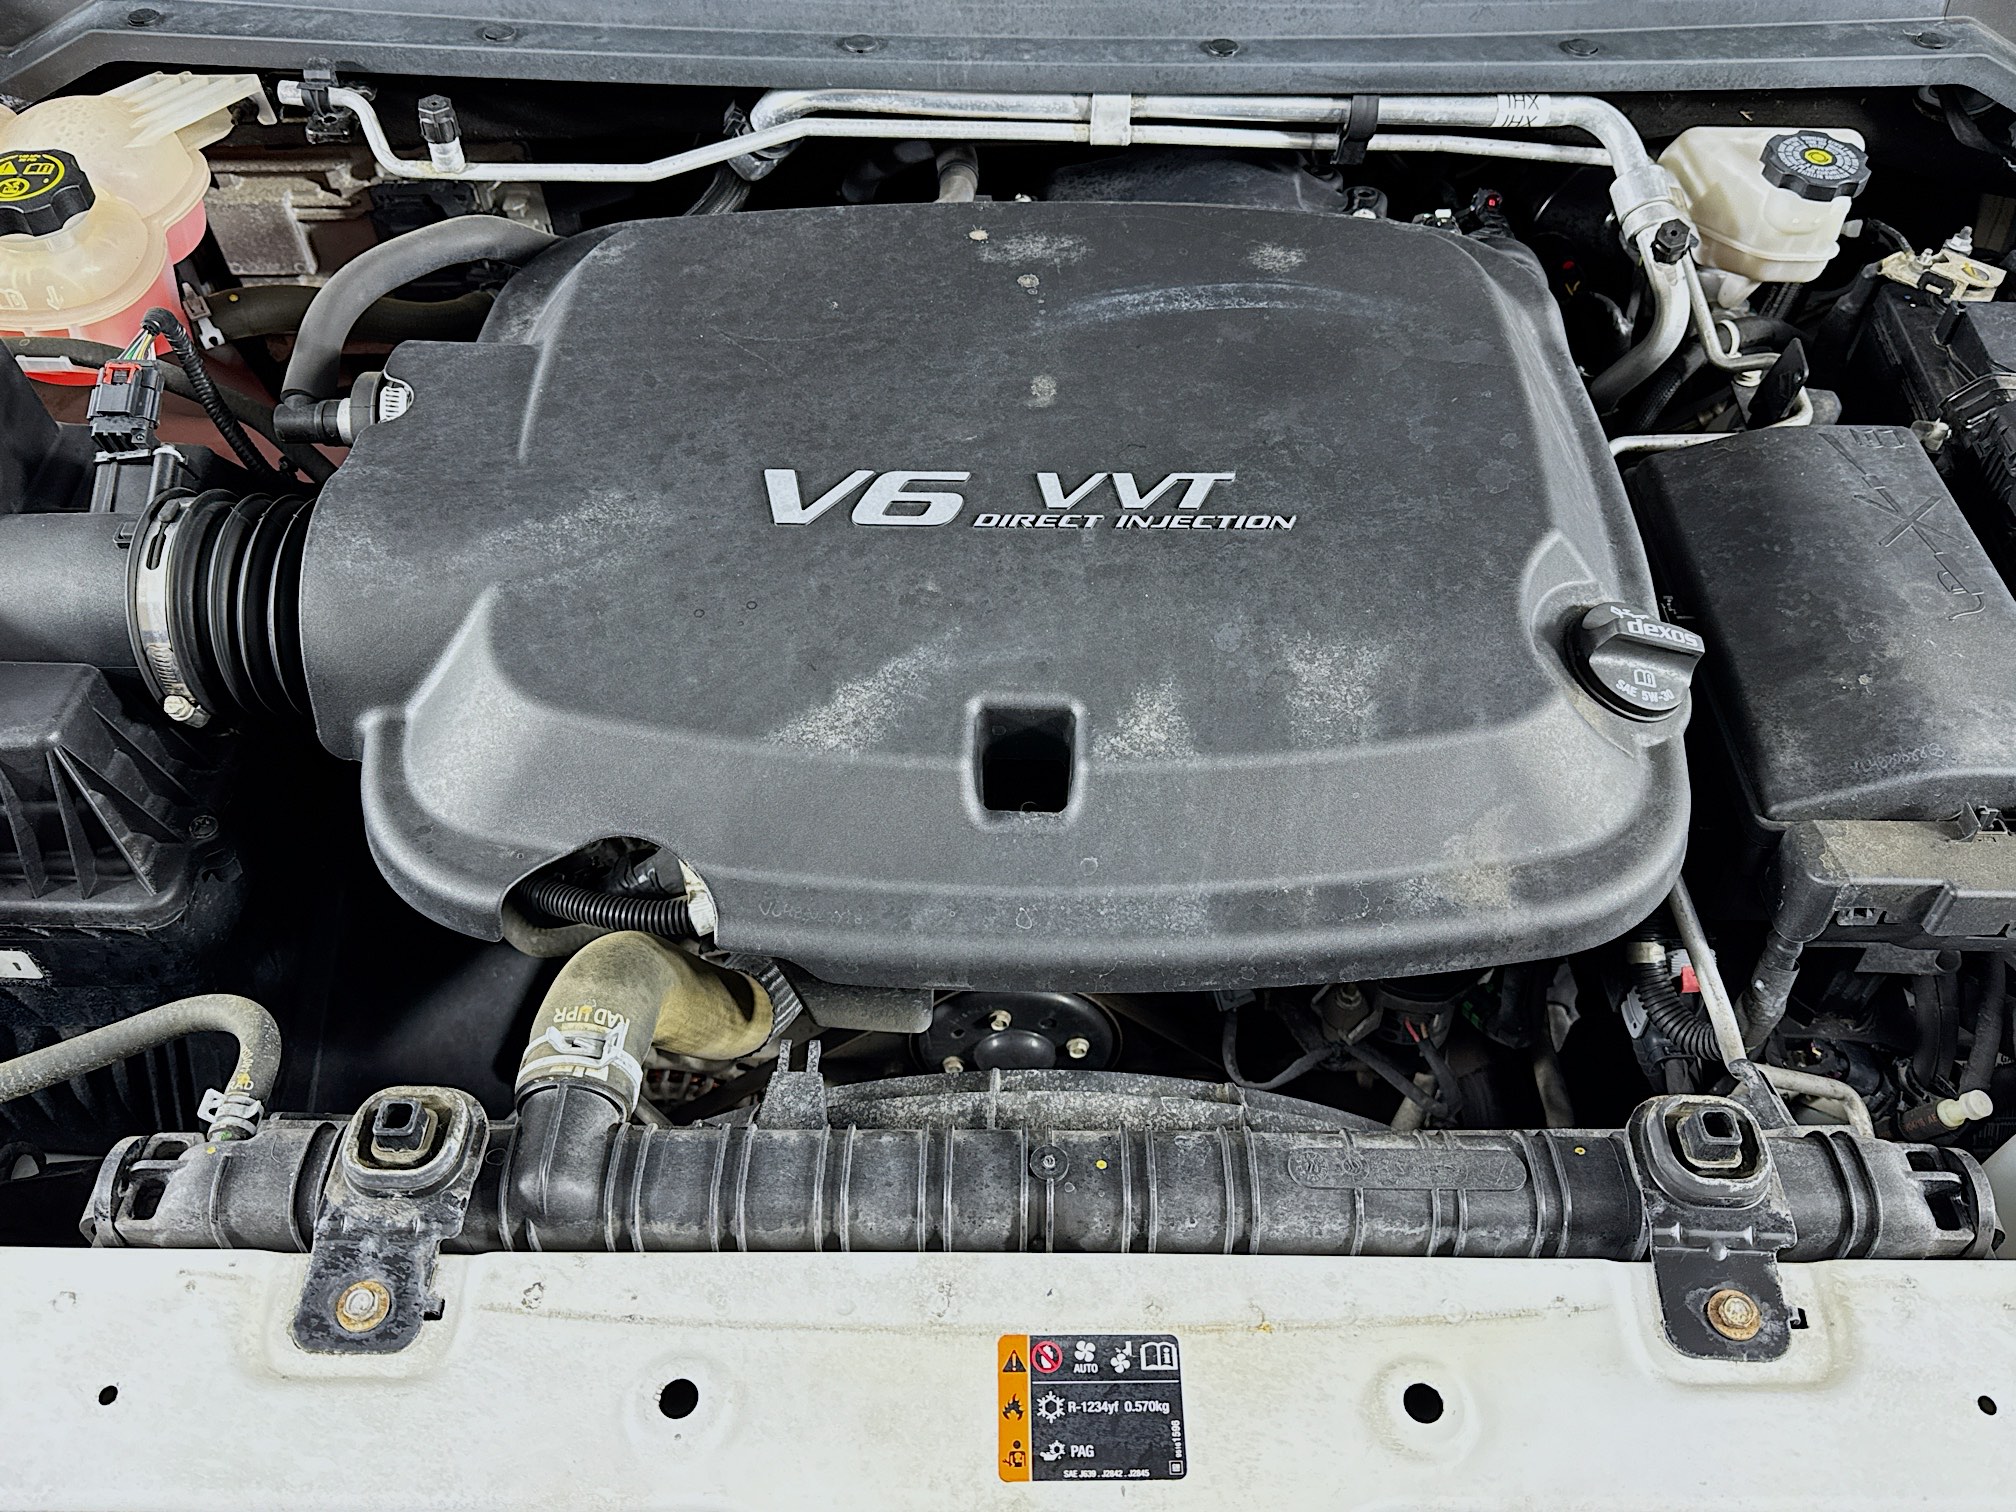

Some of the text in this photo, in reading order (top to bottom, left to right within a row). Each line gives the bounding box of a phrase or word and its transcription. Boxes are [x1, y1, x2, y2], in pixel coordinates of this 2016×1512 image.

[764, 468, 1236, 527] V6 VVT
[973, 513, 1297, 531] DIRECT INJECTION
[1627, 618, 1699, 648] dexos
[1615, 679, 1675, 702] SAE 5W-30
[1073, 1363, 1099, 1374] AUTO
[1067, 1400, 1170, 1415] R-1234yf 0.570kg
[1070, 1444, 1095, 1458] PAG
[1063, 1469, 1079, 1478] SAE
